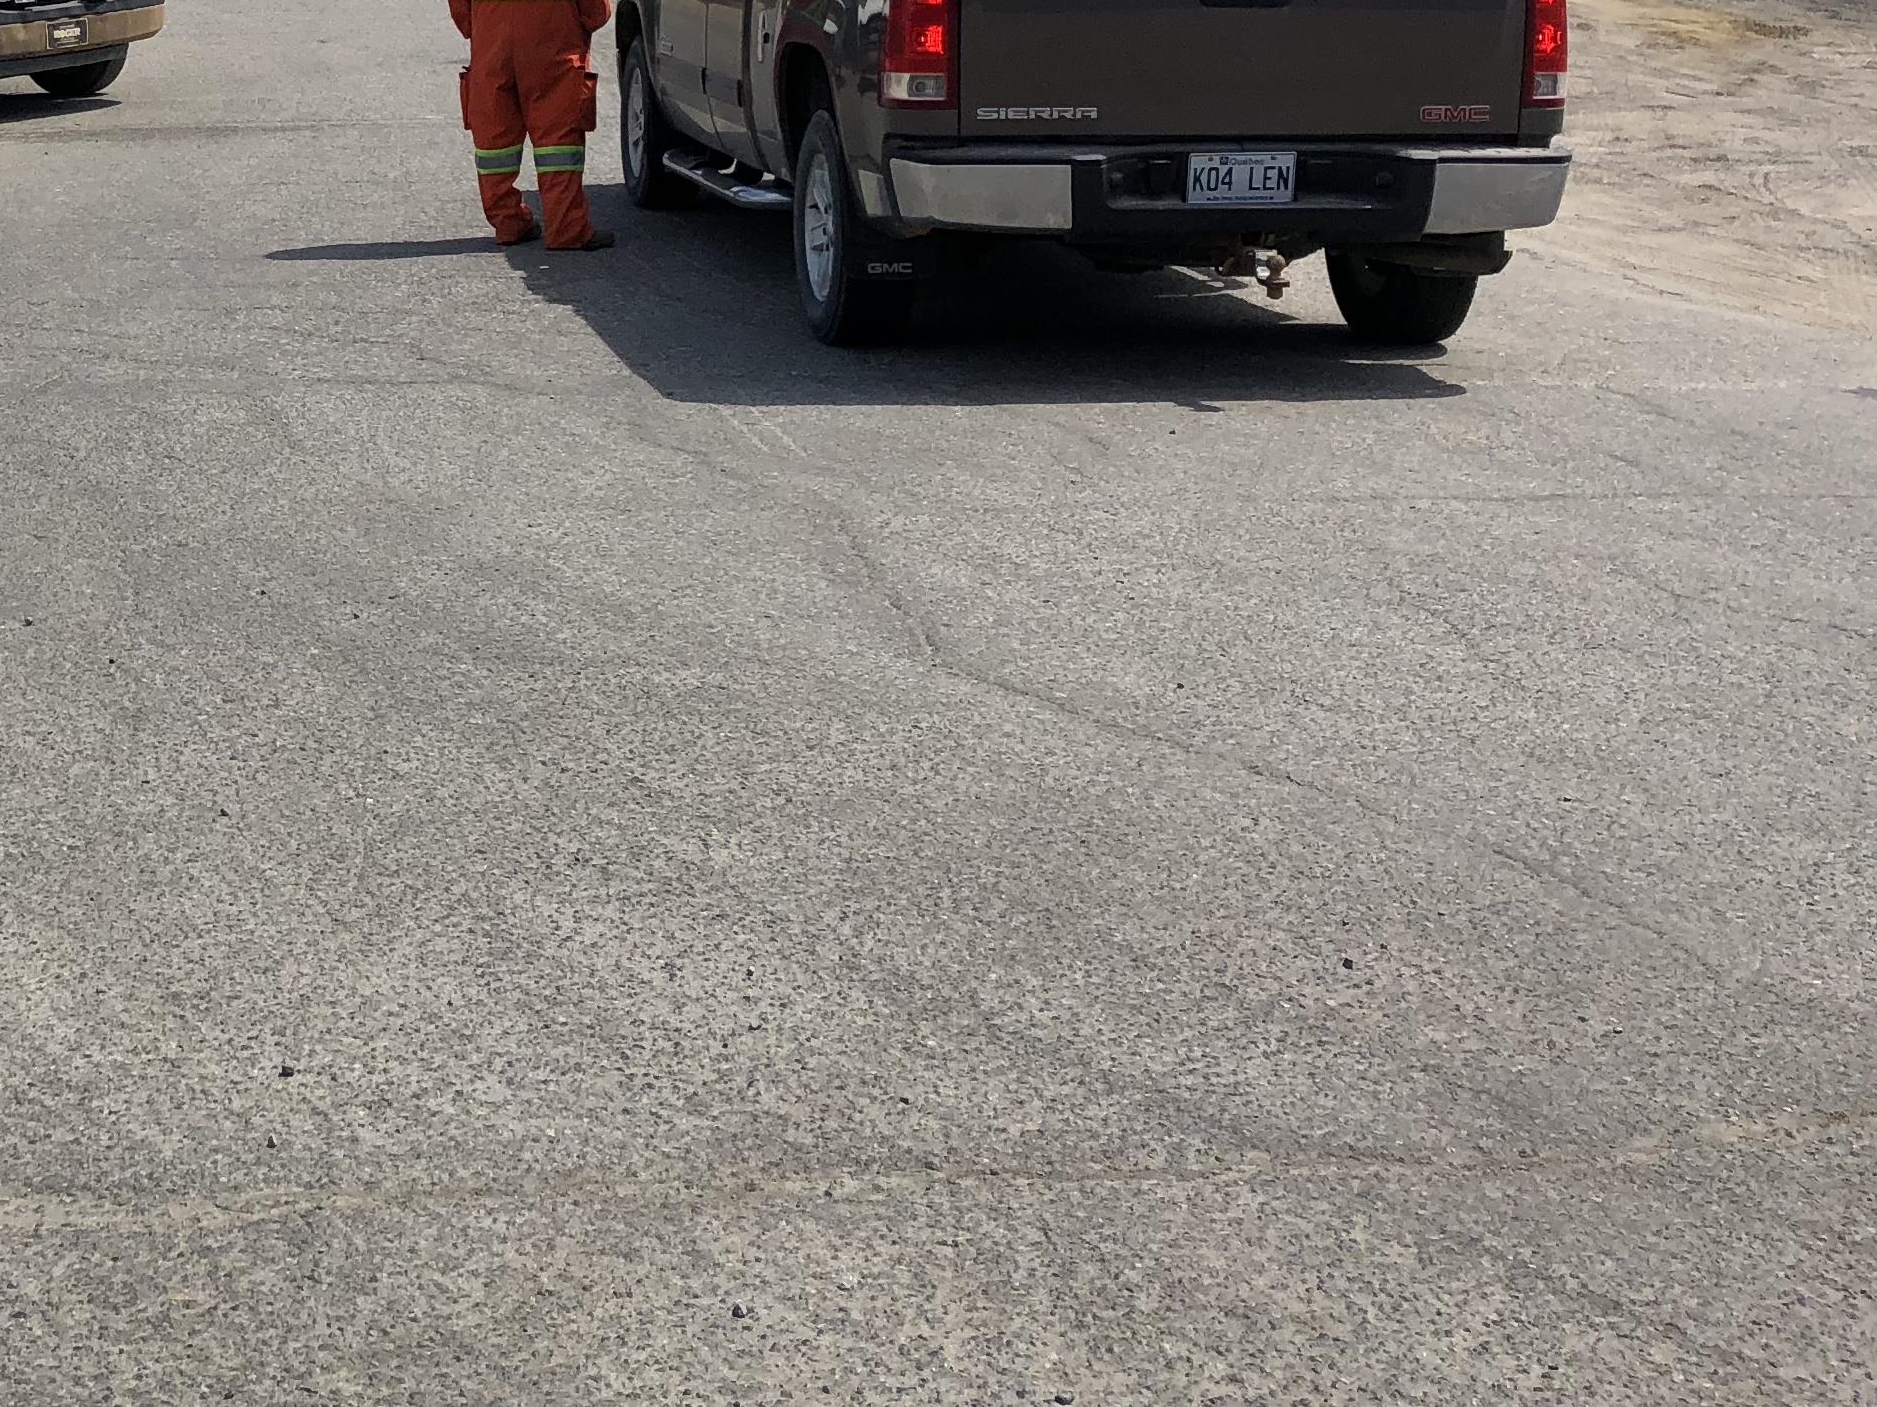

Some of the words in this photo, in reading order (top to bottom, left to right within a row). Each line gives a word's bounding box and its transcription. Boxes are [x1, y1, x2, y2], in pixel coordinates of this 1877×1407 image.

[976, 107, 1098, 120] SIERRA
[1420, 105, 1490, 122] GMC
[1192, 167, 1234, 192] K04
[1248, 166, 1291, 191] LEN
[867, 262, 913, 274] GMC
